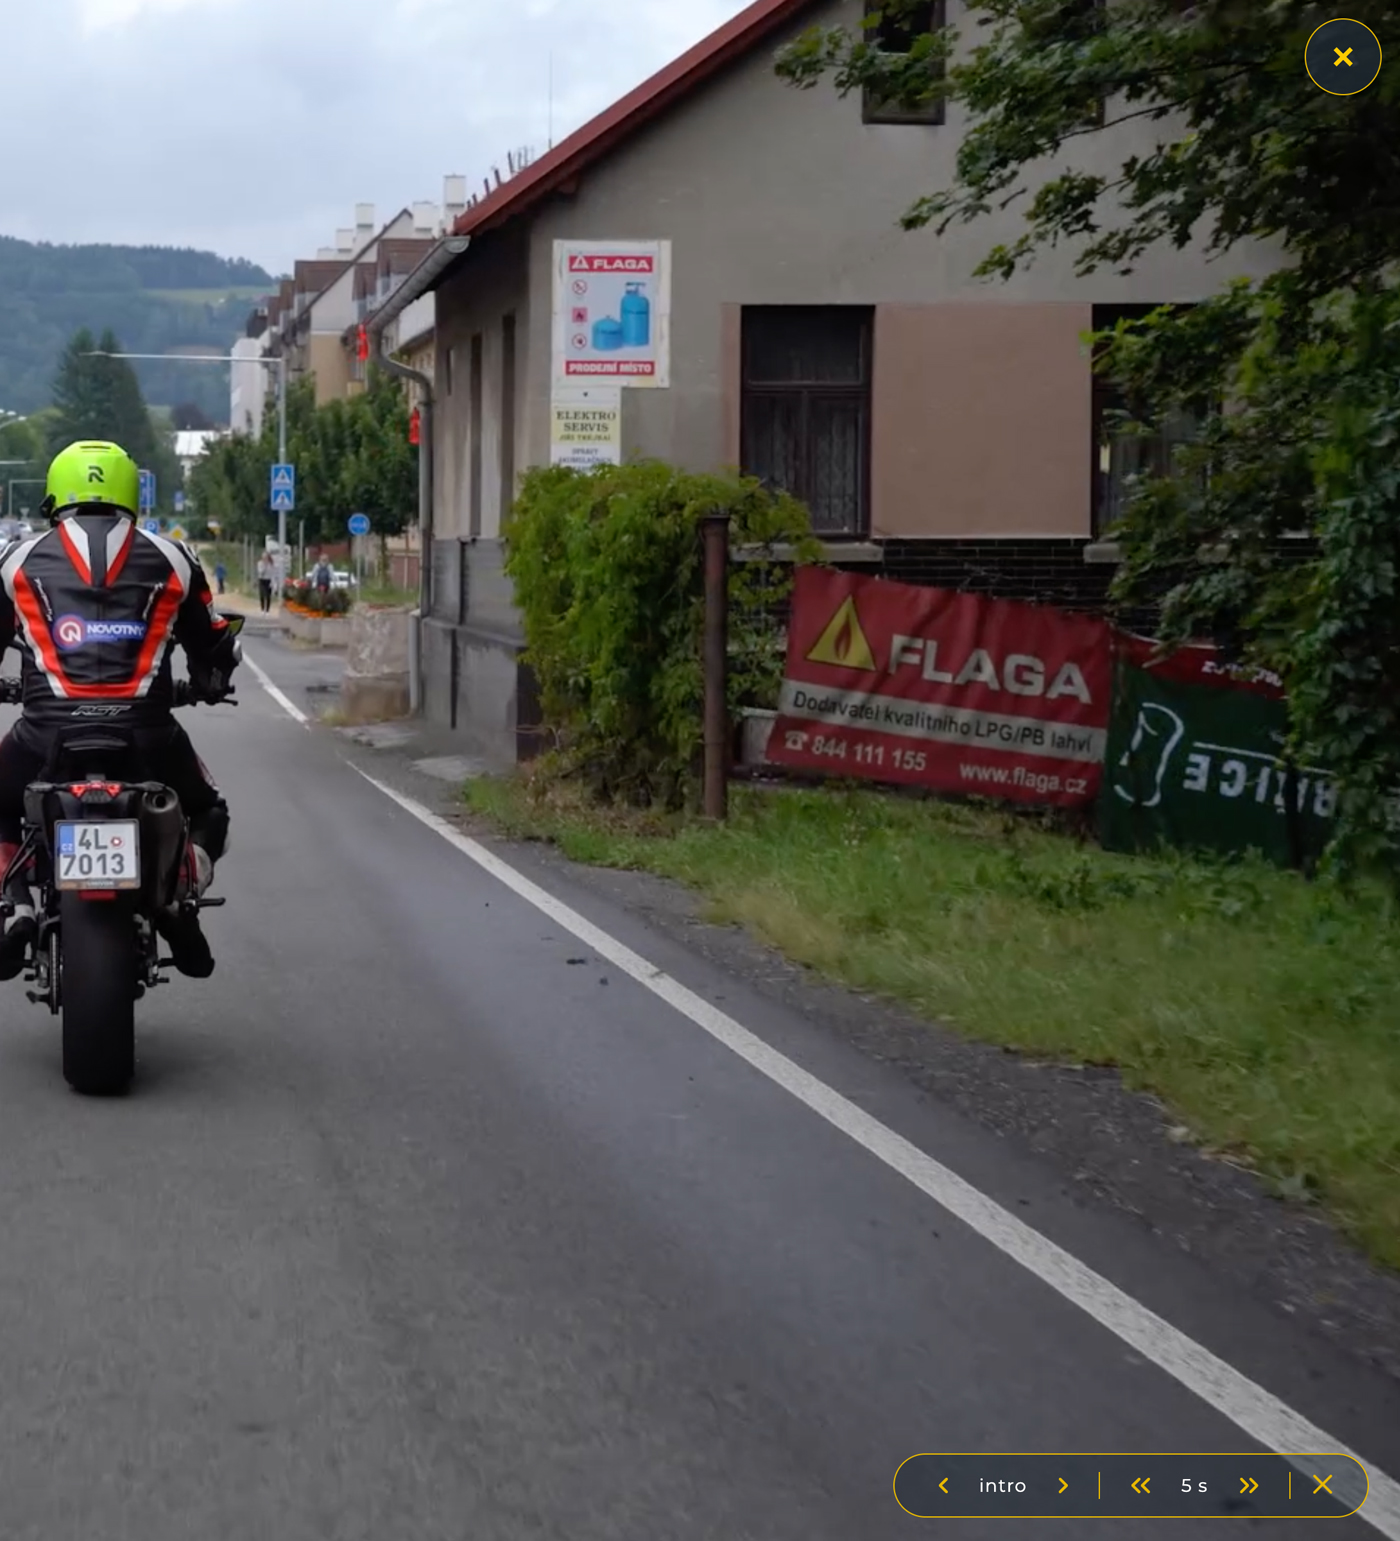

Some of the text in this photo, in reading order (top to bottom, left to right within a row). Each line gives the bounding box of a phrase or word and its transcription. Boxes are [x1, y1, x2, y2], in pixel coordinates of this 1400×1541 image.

[593, 259, 650, 270] FLAGA
[568, 361, 652, 373] PRODEJNÍ MÍSTO
[556, 411, 616, 421] ELEKTRO
[563, 423, 609, 432] SERVIS
[87, 623, 144, 636] NOVOTNY
[889, 634, 1092, 704] FLAGA
[793, 691, 1092, 753] Dodavatel kvalitního LPG/PB lahví
[812, 735, 926, 771] 844 111 155
[959, 760, 1087, 795] www.flaga.cz
[61, 843, 73, 852] CZ
[78, 828, 108, 850] 4L
[62, 853, 124, 876] 7013
